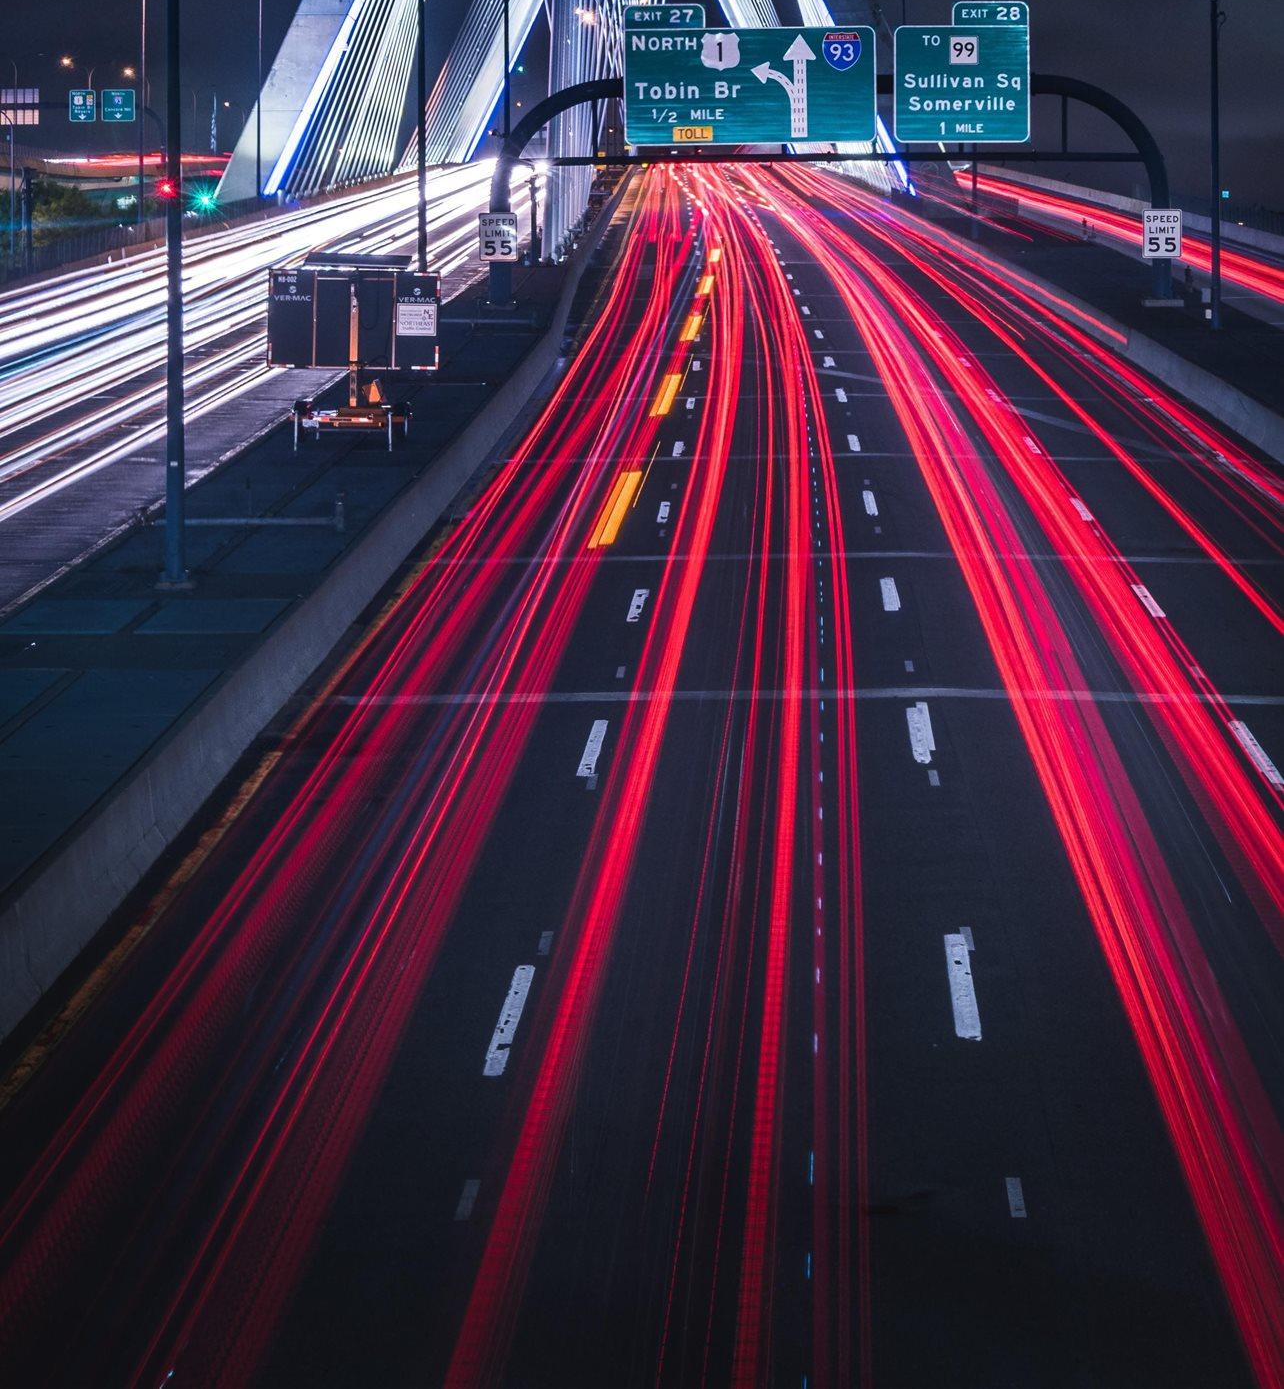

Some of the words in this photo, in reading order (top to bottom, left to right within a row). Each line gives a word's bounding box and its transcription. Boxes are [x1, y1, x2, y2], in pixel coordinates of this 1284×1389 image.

[634, 12, 662, 21] EXIT
[669, 9, 694, 23] 27
[962, 9, 988, 18] EXIT
[996, 7, 1020, 21] 28
[632, 35, 697, 51] NORTH
[922, 35, 941, 46] TO
[716, 41, 723, 62] 1
[830, 43, 854, 61] 93
[953, 42, 975, 58] 99
[904, 73, 984, 88] Sullivan
[996, 73, 1021, 90] Sq
[635, 82, 700, 99] Tobin
[714, 81, 741, 99] Br
[908, 95, 1016, 111] Somerville
[652, 108, 677, 123] 1/2
[690, 109, 725, 120] MILE
[677, 128, 709, 139] TOLL
[939, 121, 945, 135] 1
[955, 123, 984, 133] MILE
[481, 218, 515, 227] SPEED
[1146, 215, 1179, 223] SPEED
[485, 229, 511, 238] LIMIT
[1149, 226, 1176, 234] LIMIT
[484, 240, 513, 256] 55
[1148, 237, 1177, 253] 55
